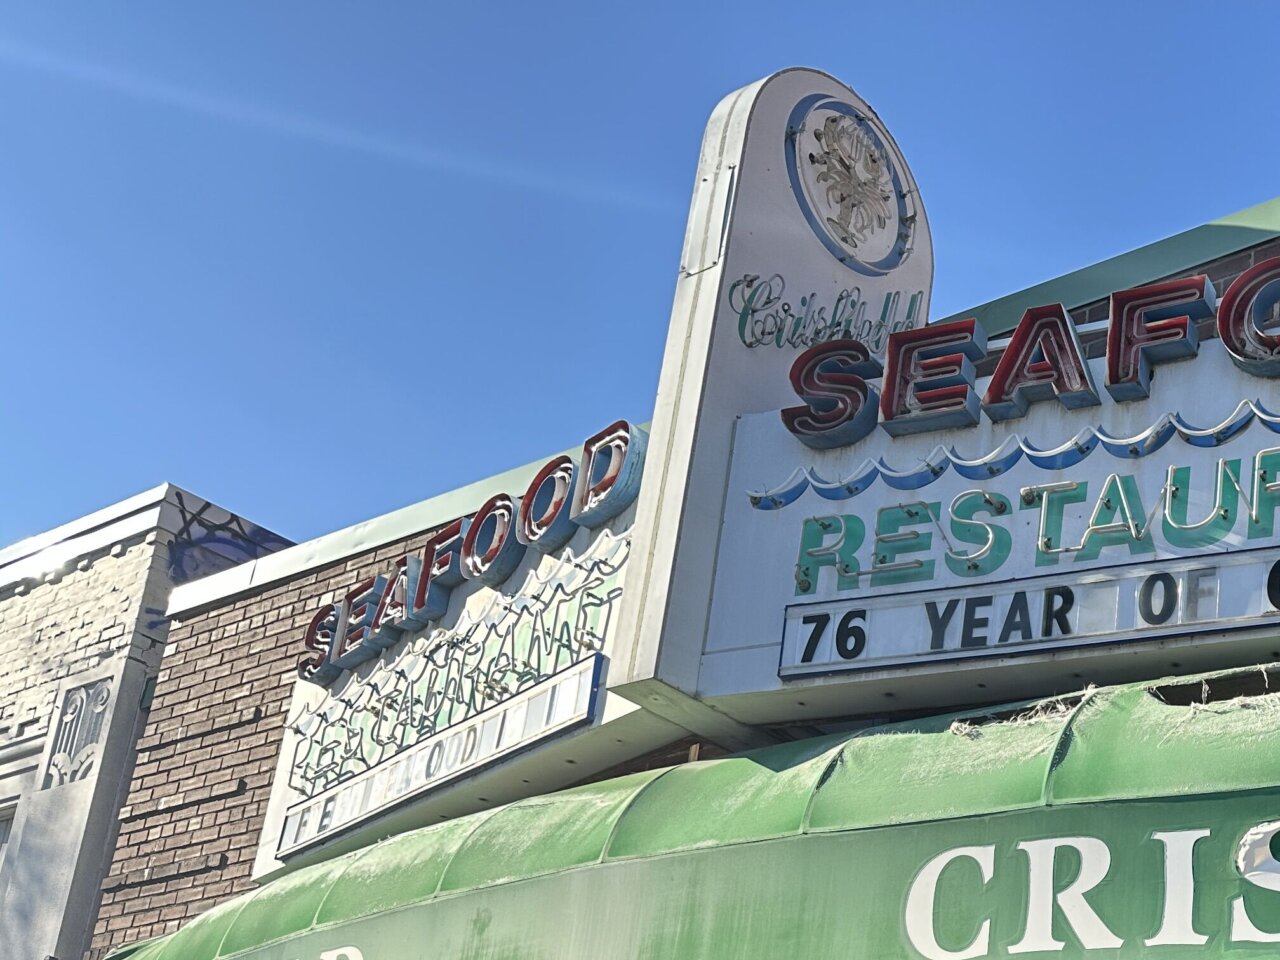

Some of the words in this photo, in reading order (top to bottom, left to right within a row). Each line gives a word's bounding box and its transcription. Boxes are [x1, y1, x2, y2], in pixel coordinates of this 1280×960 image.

[298, 420, 649, 688] SEAFOOD
[800, 609, 867, 663] 76
[925, 586, 1076, 650] YEAR
[1138, 567, 1217, 625] OF
